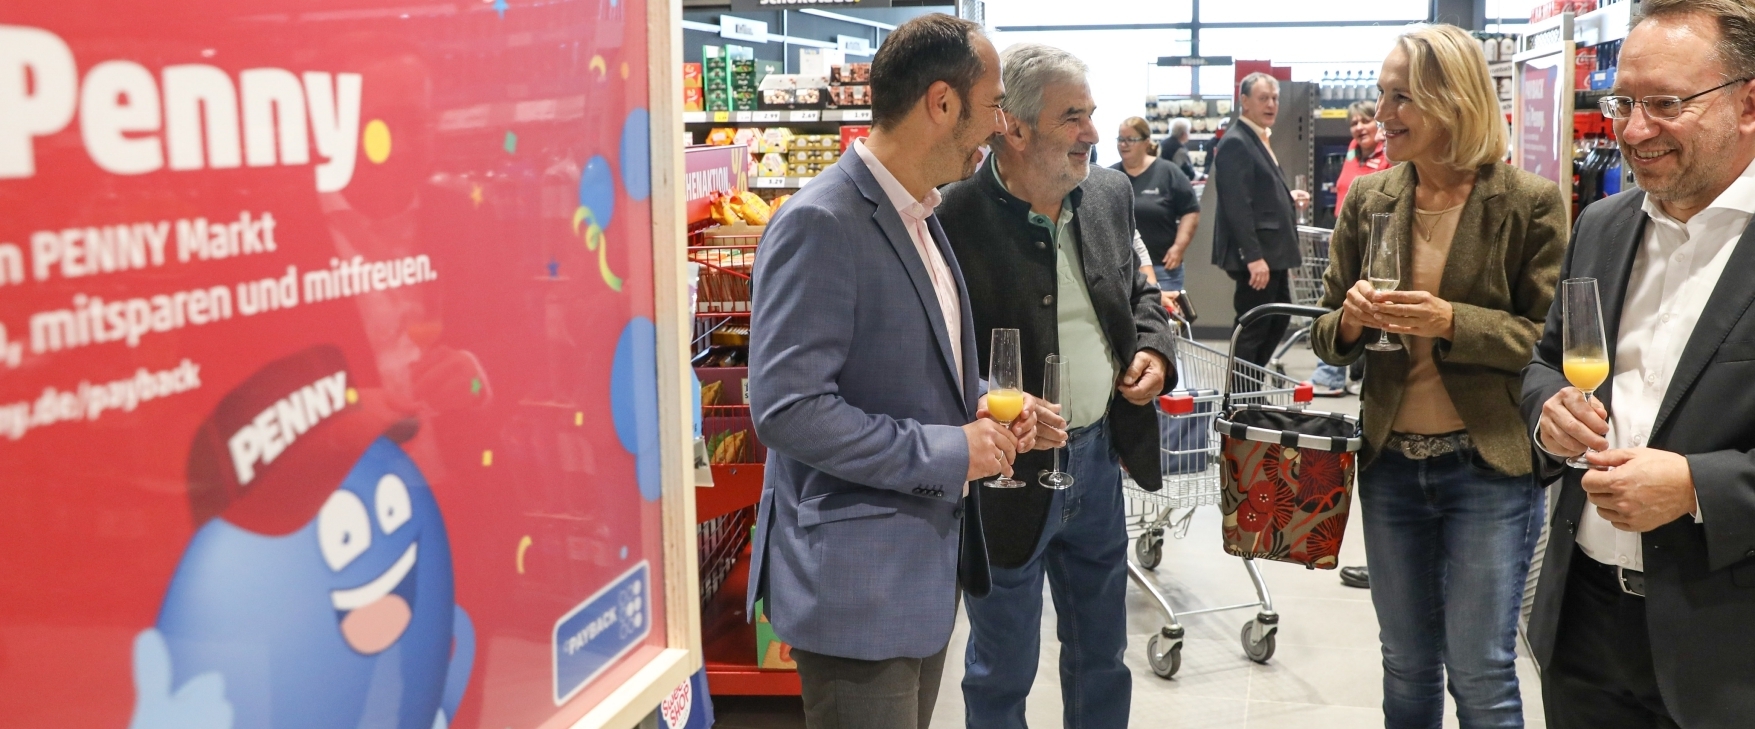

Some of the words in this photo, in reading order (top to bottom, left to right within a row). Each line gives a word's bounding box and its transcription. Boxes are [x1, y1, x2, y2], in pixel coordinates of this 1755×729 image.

[0, 25, 391, 192] Penny.
[31, 221, 170, 281] PENNY
[175, 211, 277, 263] Markt
[29, 293, 233, 348] mitsparen
[236, 264, 299, 316] und
[302, 254, 438, 304] mitfreuen.
[227, 369, 359, 486] PENNY.
[567, 606, 617, 655] PAYBACK
[662, 679, 687, 717] Swe
[670, 683, 690, 727] SHOP
